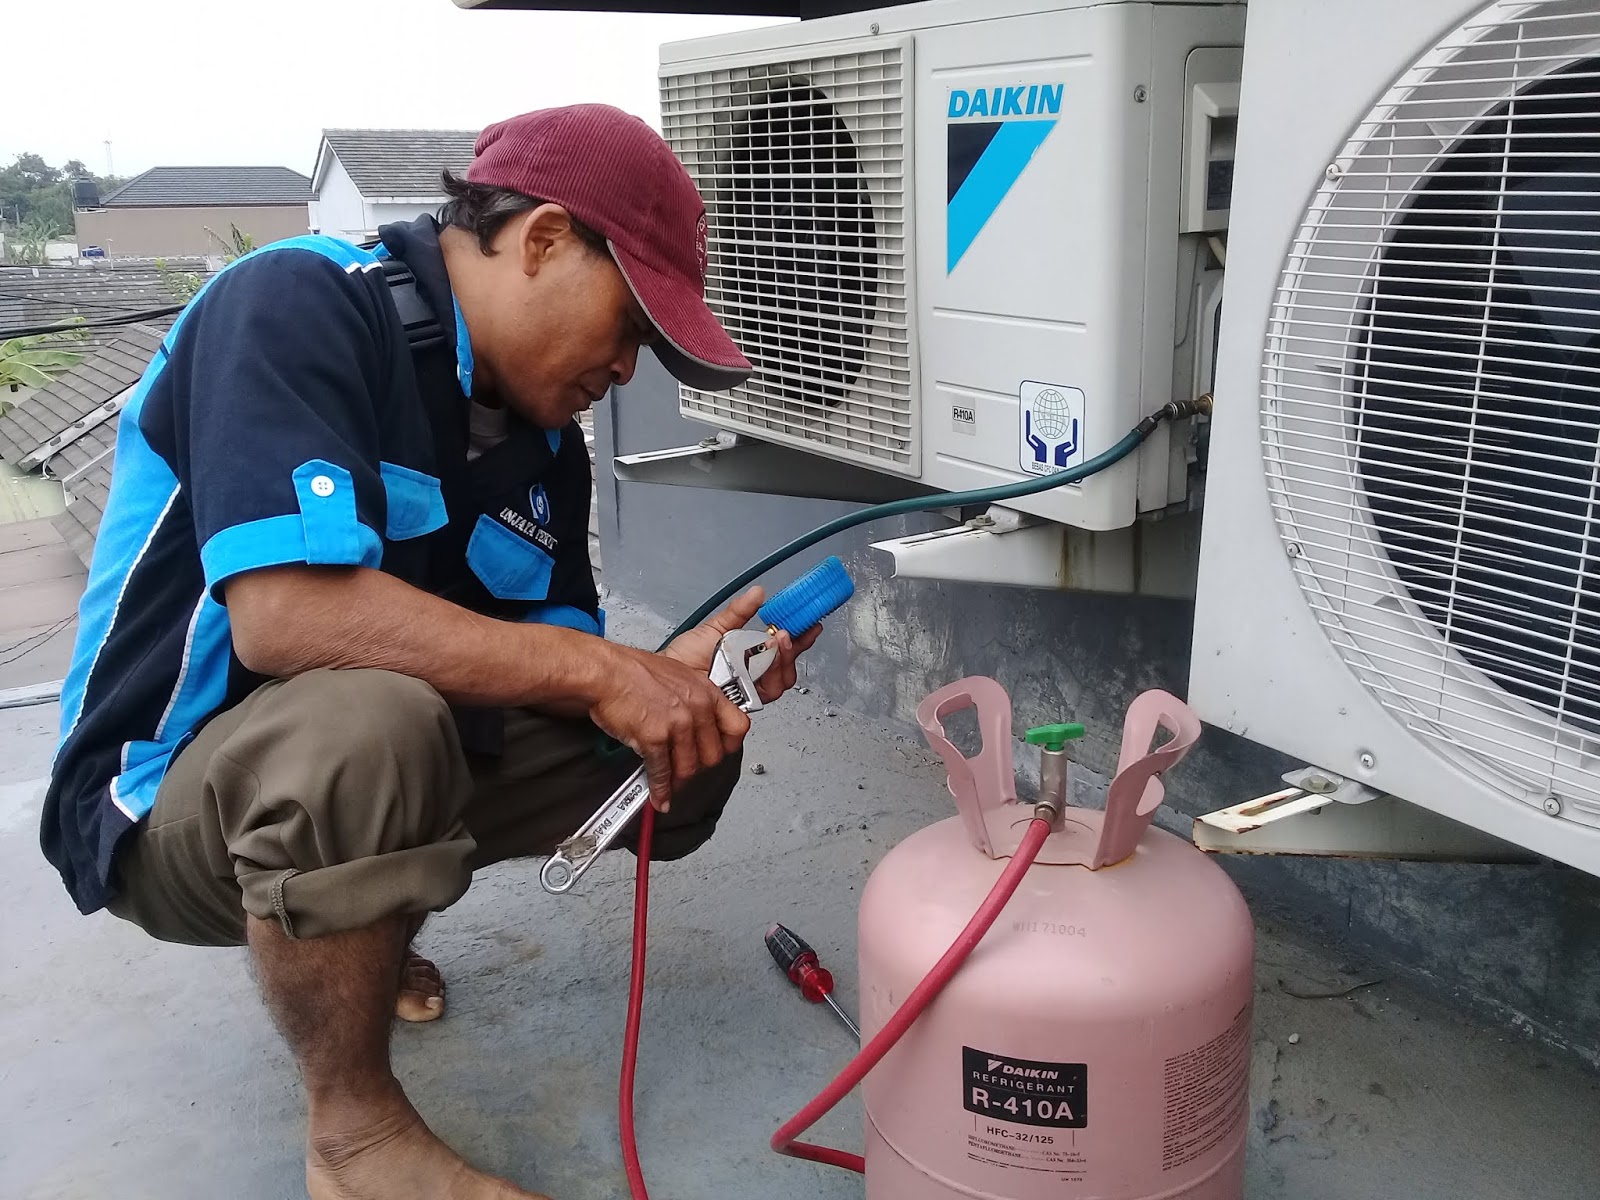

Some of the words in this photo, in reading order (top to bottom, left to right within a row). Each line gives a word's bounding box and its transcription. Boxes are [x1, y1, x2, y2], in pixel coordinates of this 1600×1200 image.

[947, 83, 1064, 118] DAIKIN
[953, 408, 974, 422] R410A
[972, 1071, 1075, 1094] REFRIGERANT
[1002, 1065, 1059, 1080] DAIKIN
[972, 1086, 1074, 1120] R-410A
[986, 1126, 1054, 1145] HFC-32/125
